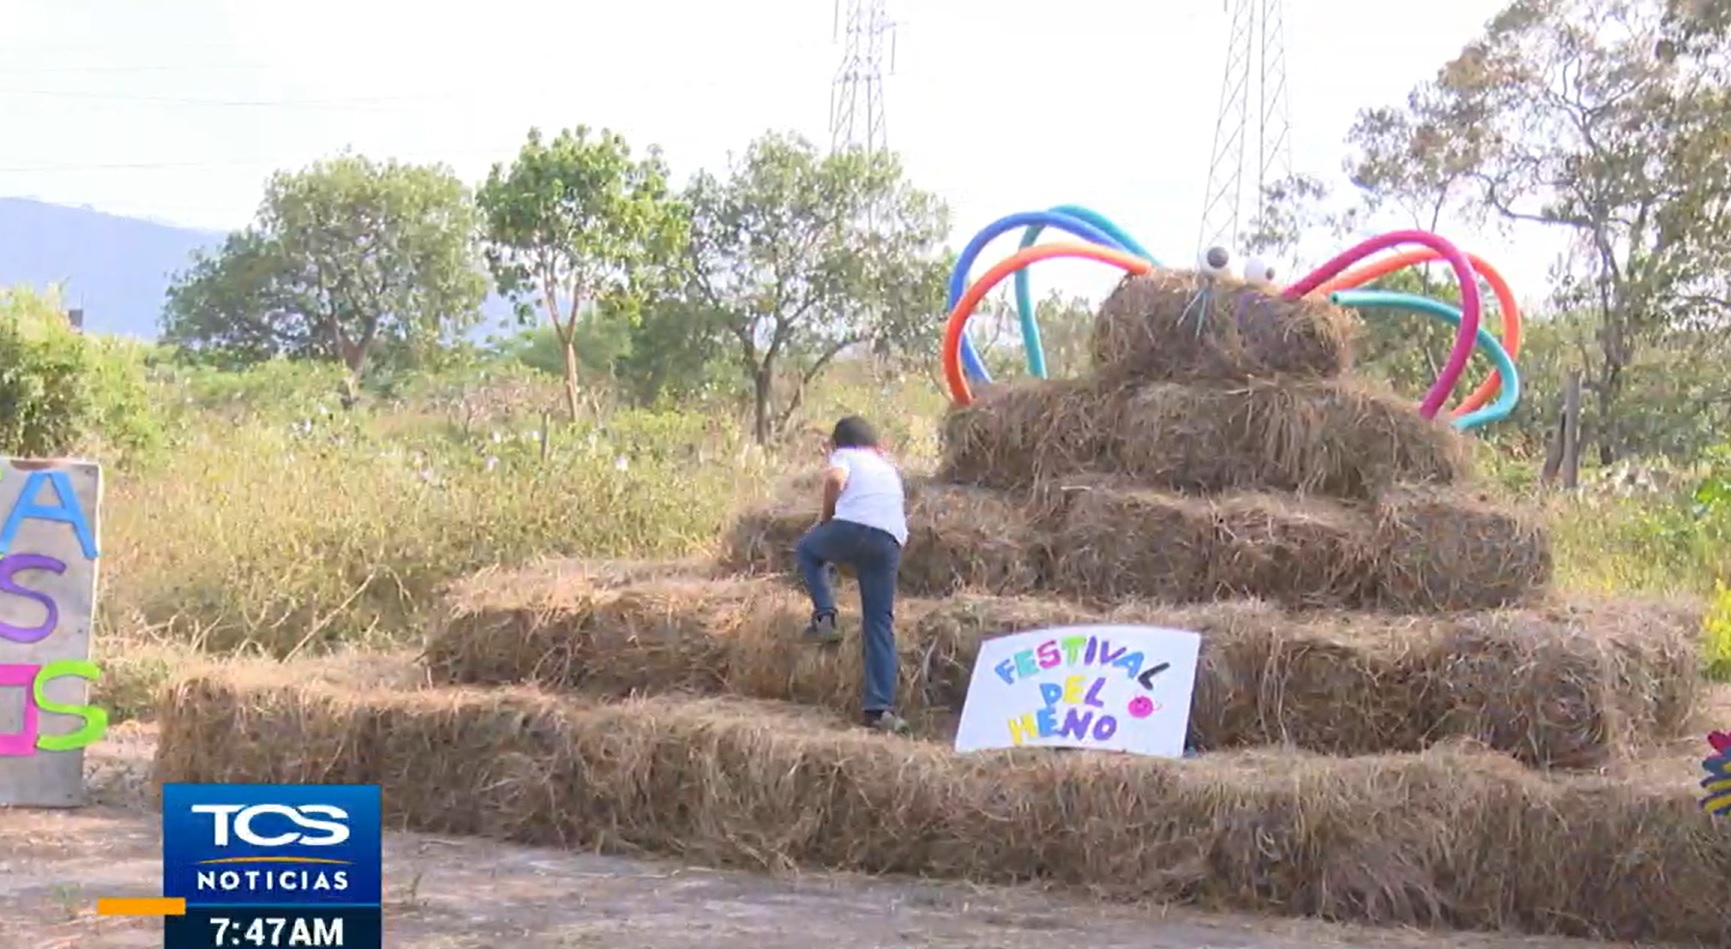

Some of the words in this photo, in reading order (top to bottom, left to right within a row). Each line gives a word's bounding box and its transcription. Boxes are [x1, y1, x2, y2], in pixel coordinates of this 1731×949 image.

[994, 635, 1170, 690] FESTIVAL
[1039, 675, 1106, 708] DEL
[1008, 707, 1117, 745] HENO
